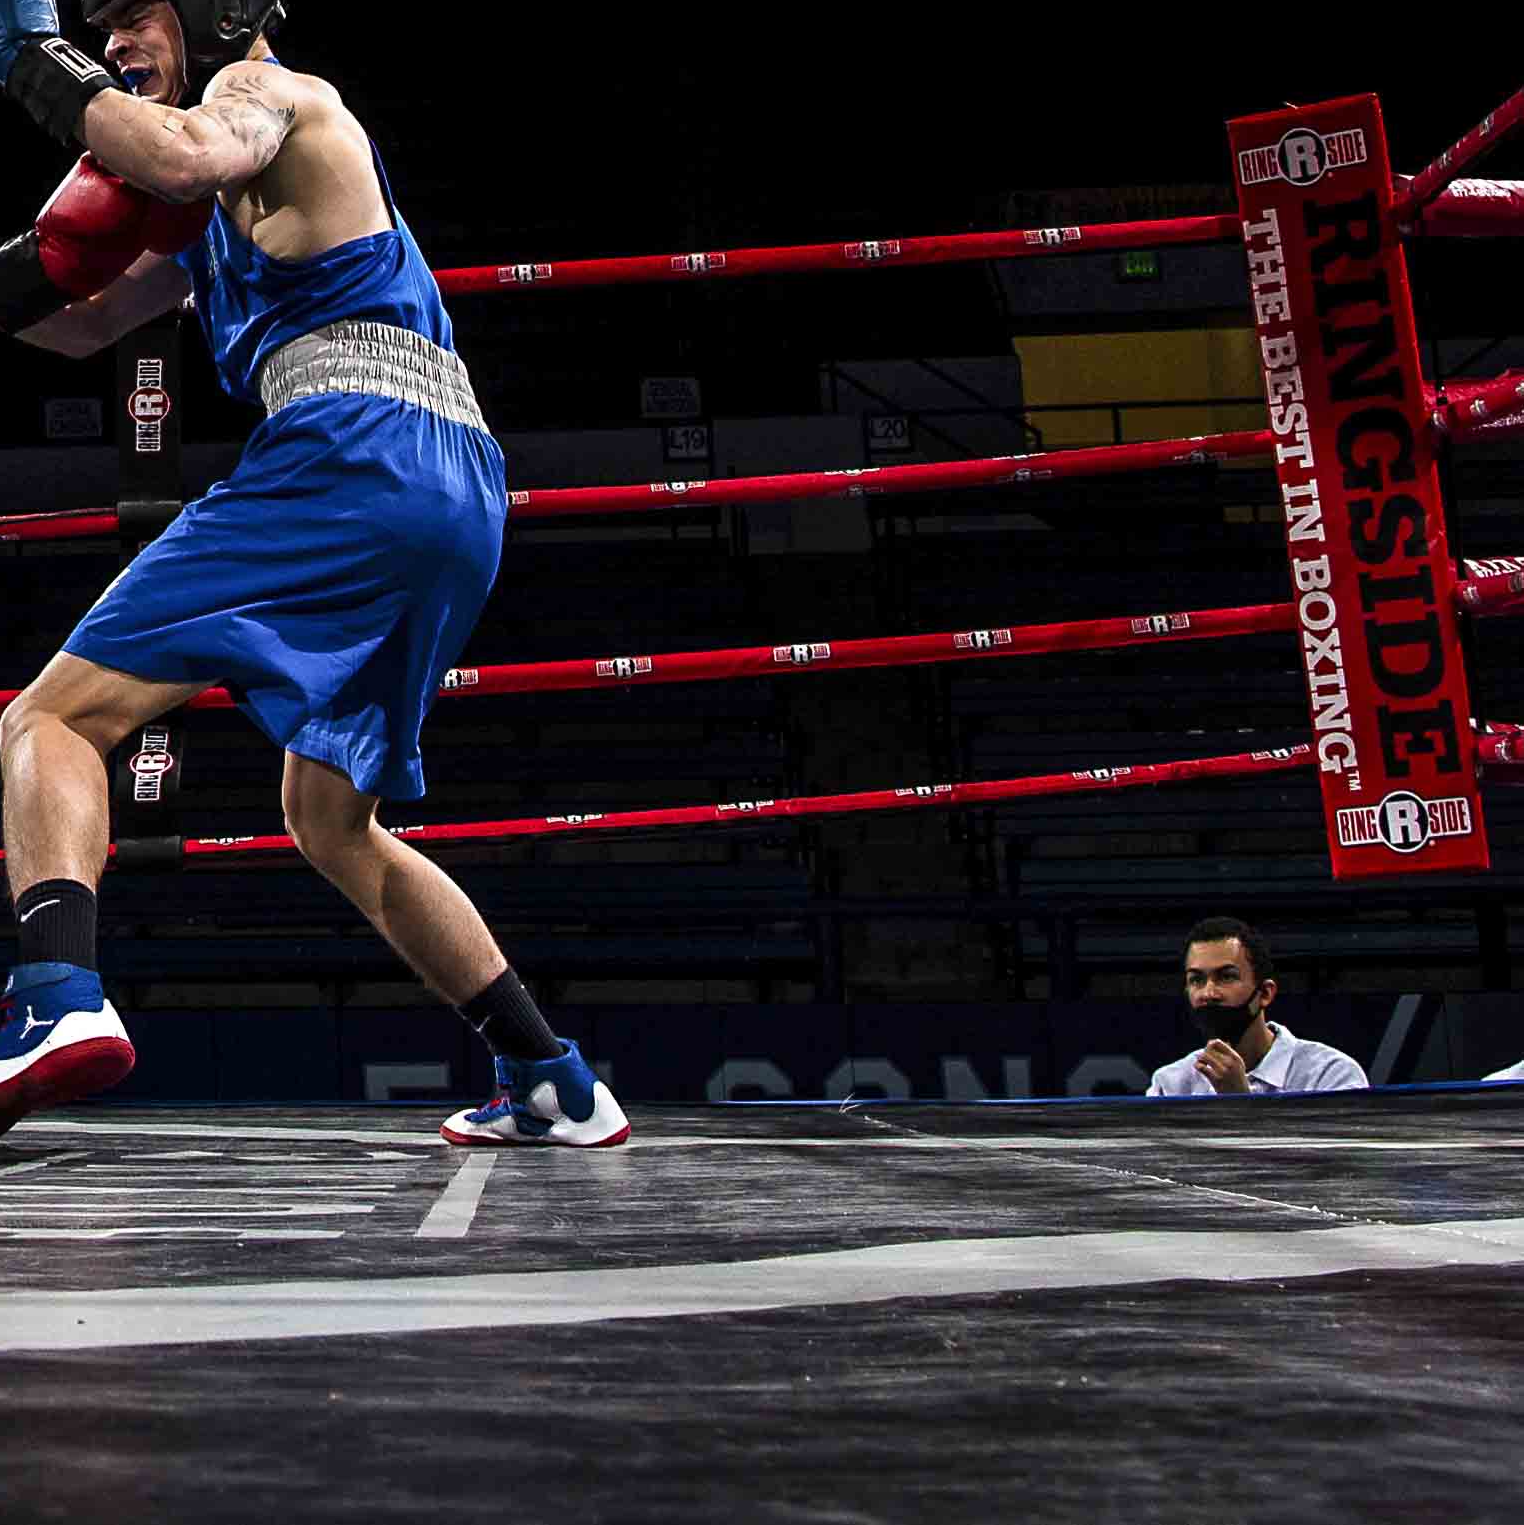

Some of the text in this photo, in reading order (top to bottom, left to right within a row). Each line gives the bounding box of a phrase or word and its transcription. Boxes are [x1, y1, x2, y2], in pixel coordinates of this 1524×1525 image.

[1241, 151, 1280, 184] RING
[1326, 131, 1367, 166] SIDE
[1242, 207, 1292, 325] THE
[871, 419, 907, 439] L20
[1260, 331, 1315, 469] BEST
[1282, 479, 1326, 543] IN
[1302, 189, 1463, 779] RINGSIDE
[1338, 800, 1468, 845] RING R SIDE
